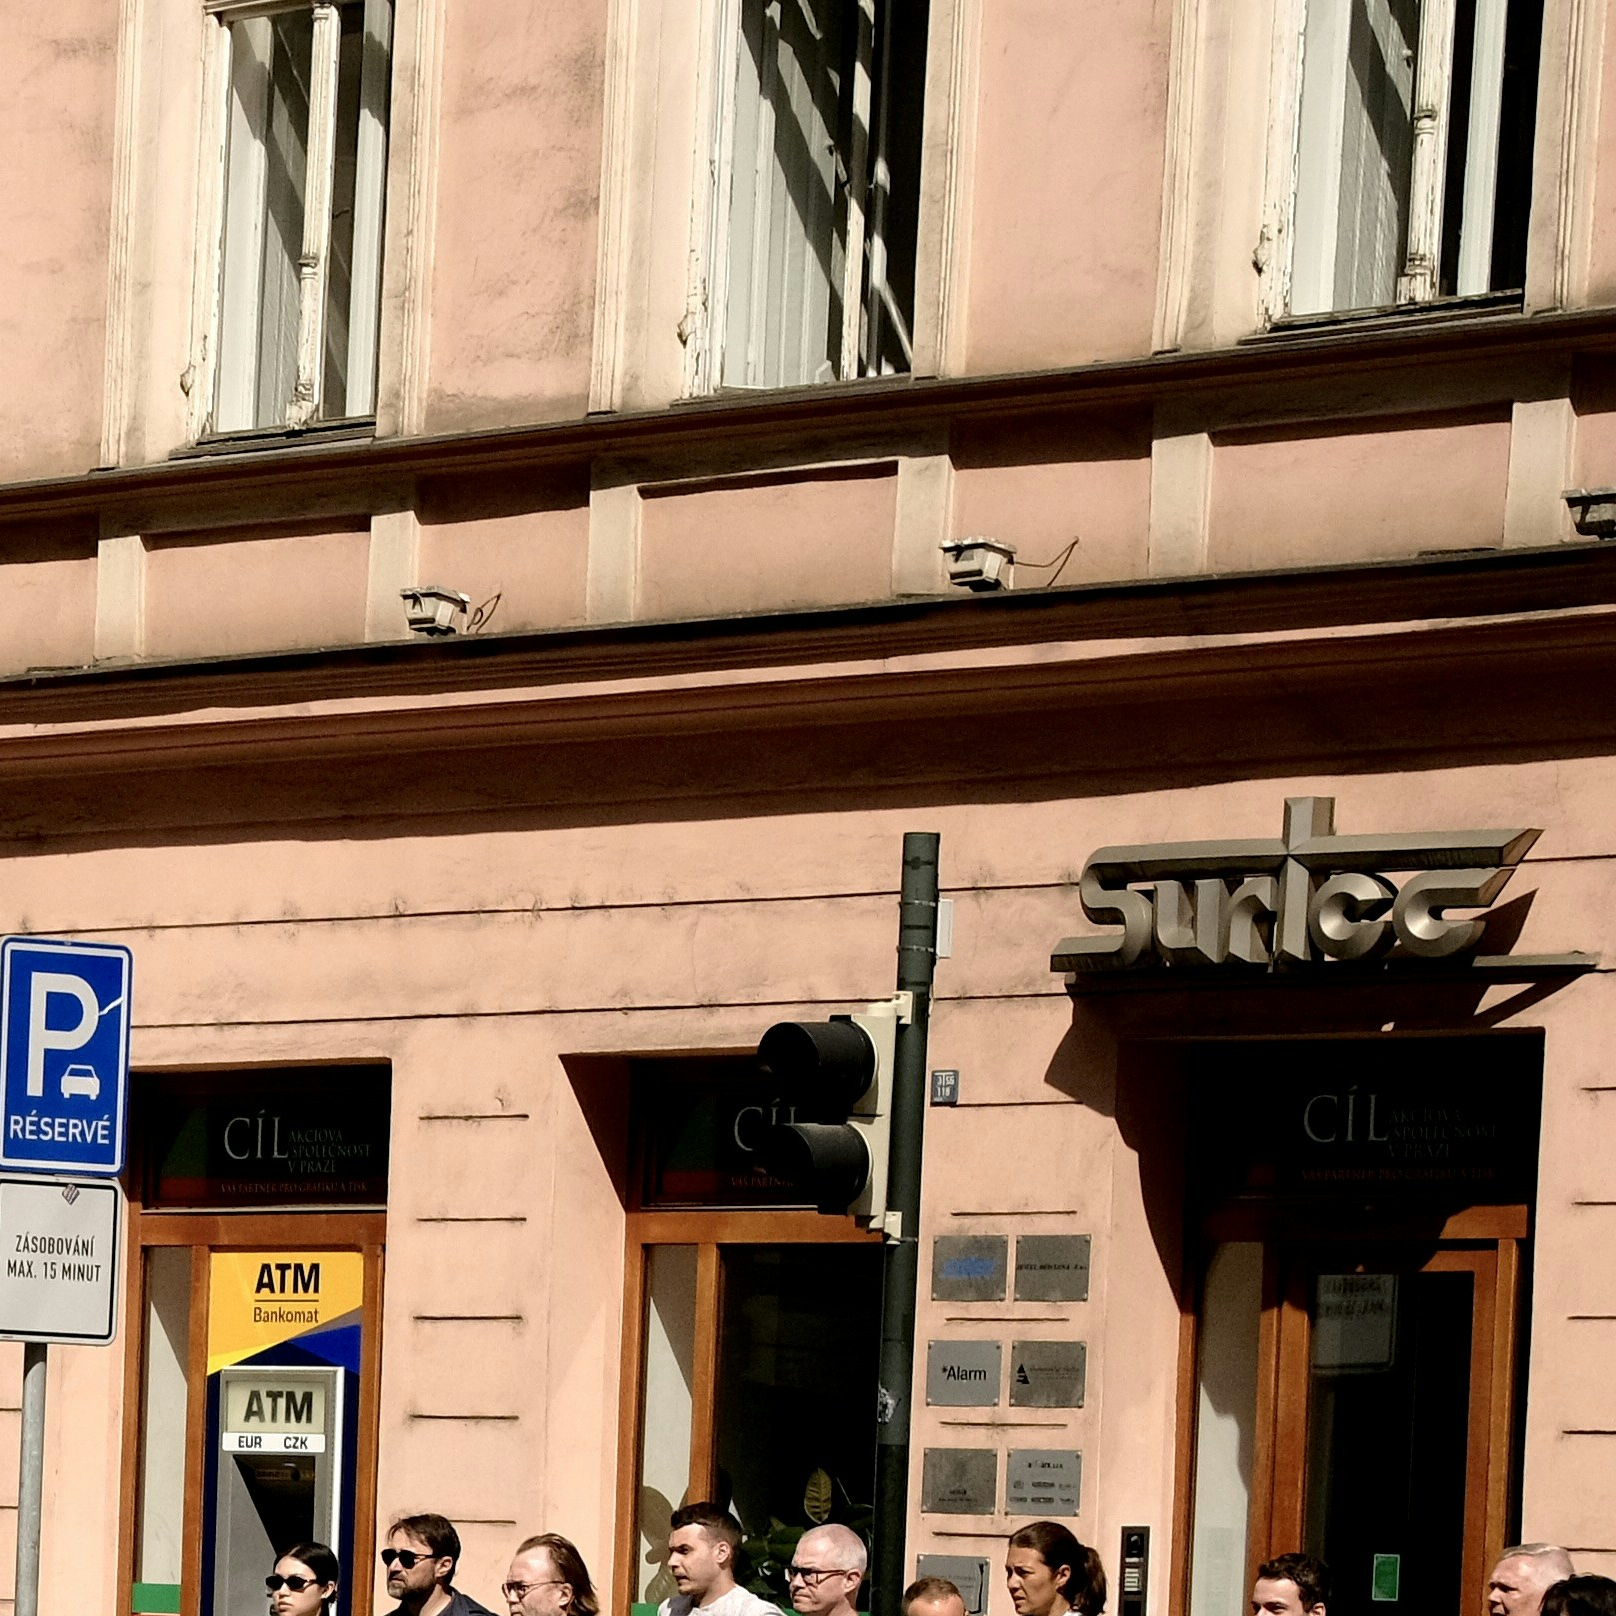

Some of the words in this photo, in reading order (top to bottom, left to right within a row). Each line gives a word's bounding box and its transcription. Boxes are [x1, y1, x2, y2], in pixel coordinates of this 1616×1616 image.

[27, 971, 99, 1097] P
[8, 1110, 111, 1145] RÉSERVÉ
[1303, 1085, 1389, 1143] CÍL
[224, 1109, 288, 1159] CÍL
[300, 1160, 338, 1173] PRAZE
[15, 1232, 96, 1257] ZÁSOBOVÁNÍ
[7, 1260, 37, 1280] MAX.
[43, 1261, 57, 1280] 15
[61, 1262, 102, 1282] MINUT
[254, 1262, 320, 1295] ATM
[253, 1306, 319, 1324] Bankomat
[946, 1365, 987, 1381] Alarm
[243, 1390, 313, 1424] ATM
[238, 1435, 262, 1449] EUR
[283, 1436, 308, 1450] CZK
